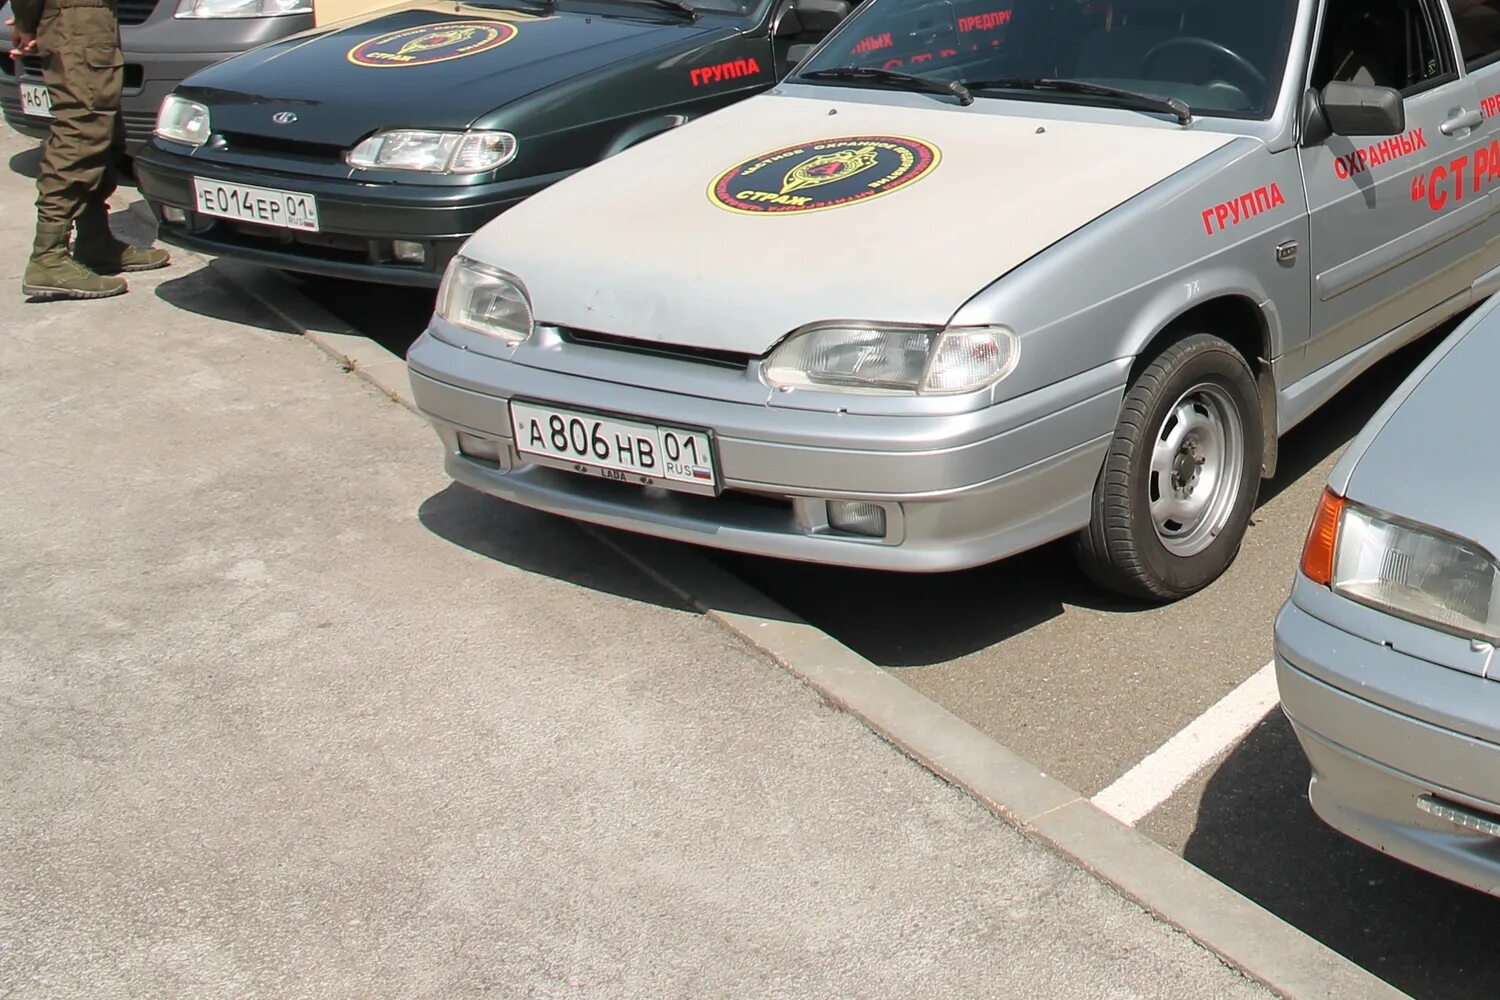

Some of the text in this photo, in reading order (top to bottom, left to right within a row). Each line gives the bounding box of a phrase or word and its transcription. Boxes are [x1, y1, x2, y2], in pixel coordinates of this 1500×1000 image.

[689, 57, 761, 88] ГРУППА
[740, 149, 805, 176] ЧАСТНОЕ
[813, 141, 897, 152] ОХРАННОЕ
[1201, 182, 1285, 236] ГРУППА
[1333, 127, 1428, 181] ОХРАННЫХ
[204, 186, 308, 222] Е014ЕР 01
[736, 190, 813, 206] СТРАЖ
[288, 216, 304, 226] RUS
[529, 413, 700, 468] А806НВ 01
[601, 468, 628, 482] LADA
[666, 461, 692, 477] RUS
